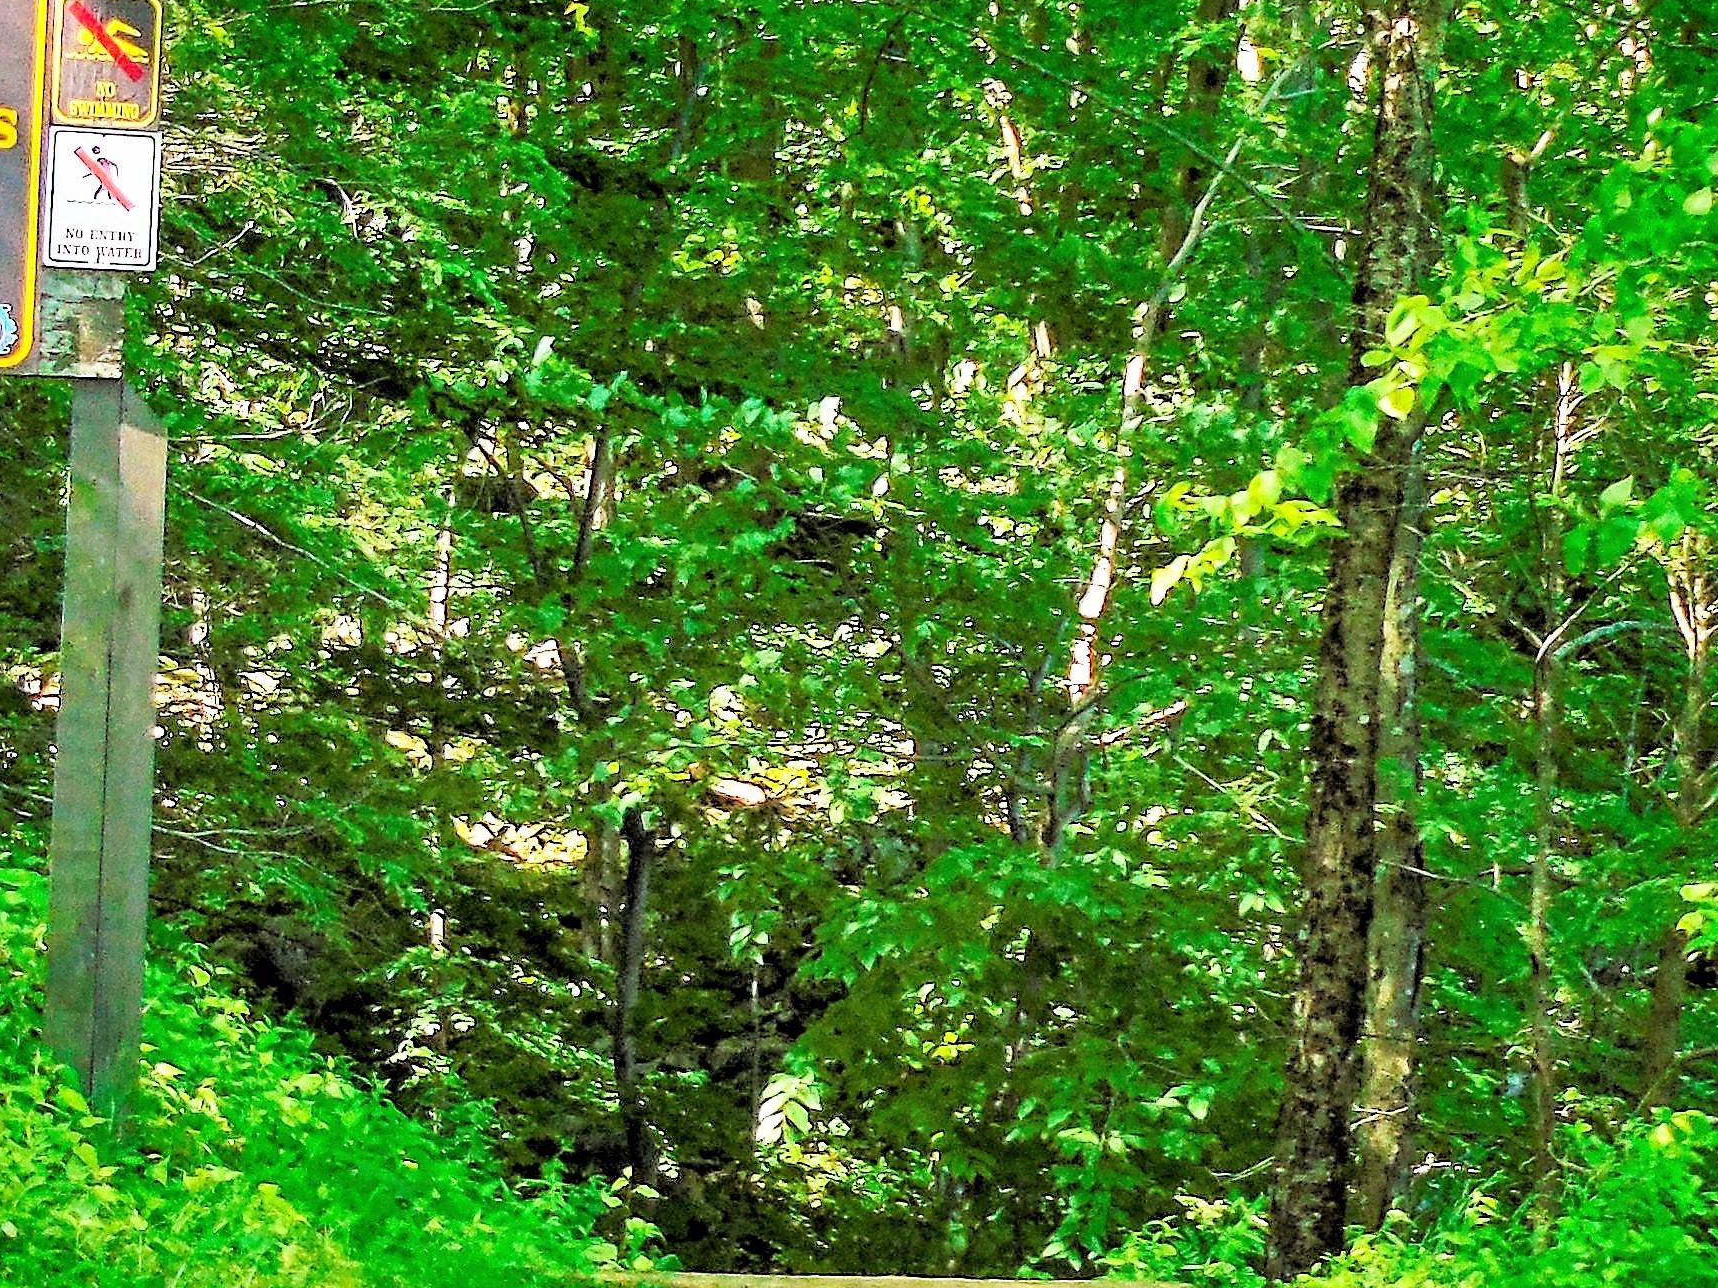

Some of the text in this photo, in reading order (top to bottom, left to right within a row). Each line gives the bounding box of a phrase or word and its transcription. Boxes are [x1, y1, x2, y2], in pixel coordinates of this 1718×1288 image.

[96, 81, 115, 98] NO
[70, 101, 139, 119] SWIMMING
[65, 228, 135, 242] NO ENTRY
[57, 244, 141, 259] INTO WATER
